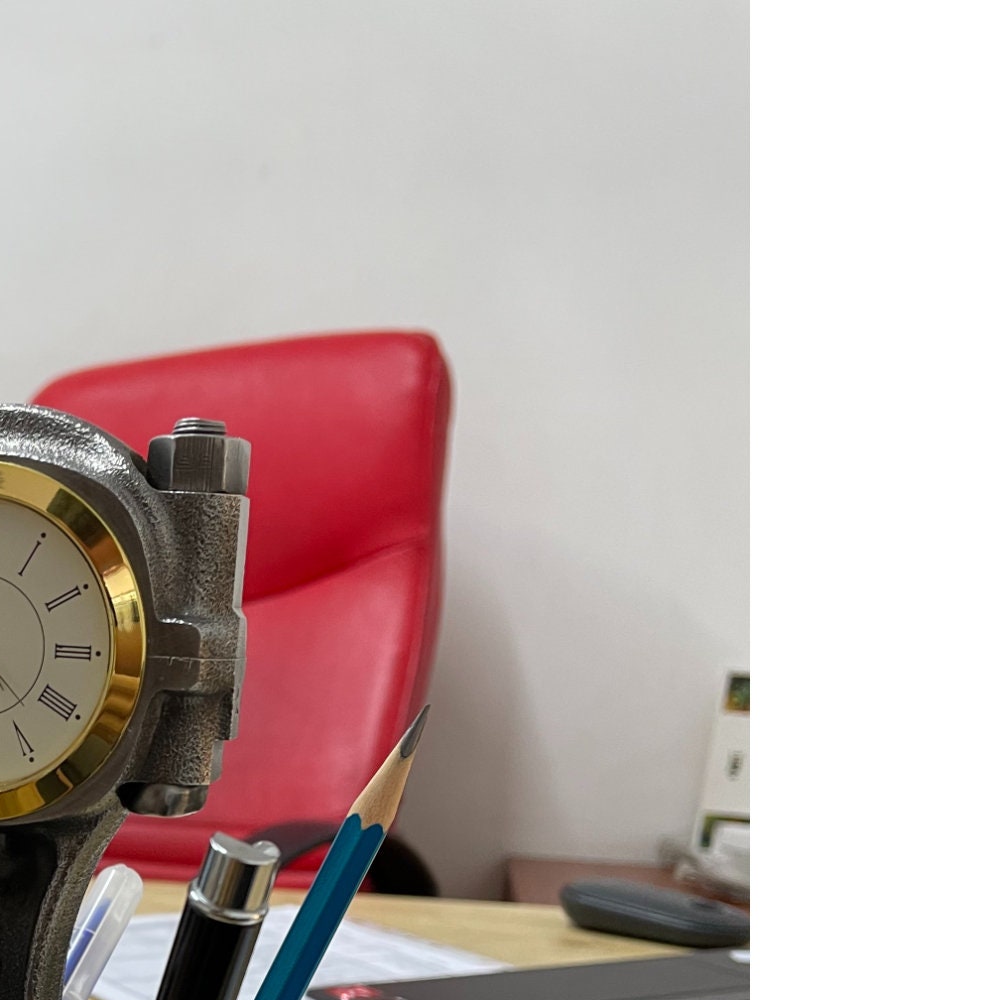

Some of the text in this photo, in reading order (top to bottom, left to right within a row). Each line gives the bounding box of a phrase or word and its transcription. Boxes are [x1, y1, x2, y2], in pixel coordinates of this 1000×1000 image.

[45, 585, 81, 612] II
[55, 643, 92, 661] III
[12, 720, 34, 756] V
